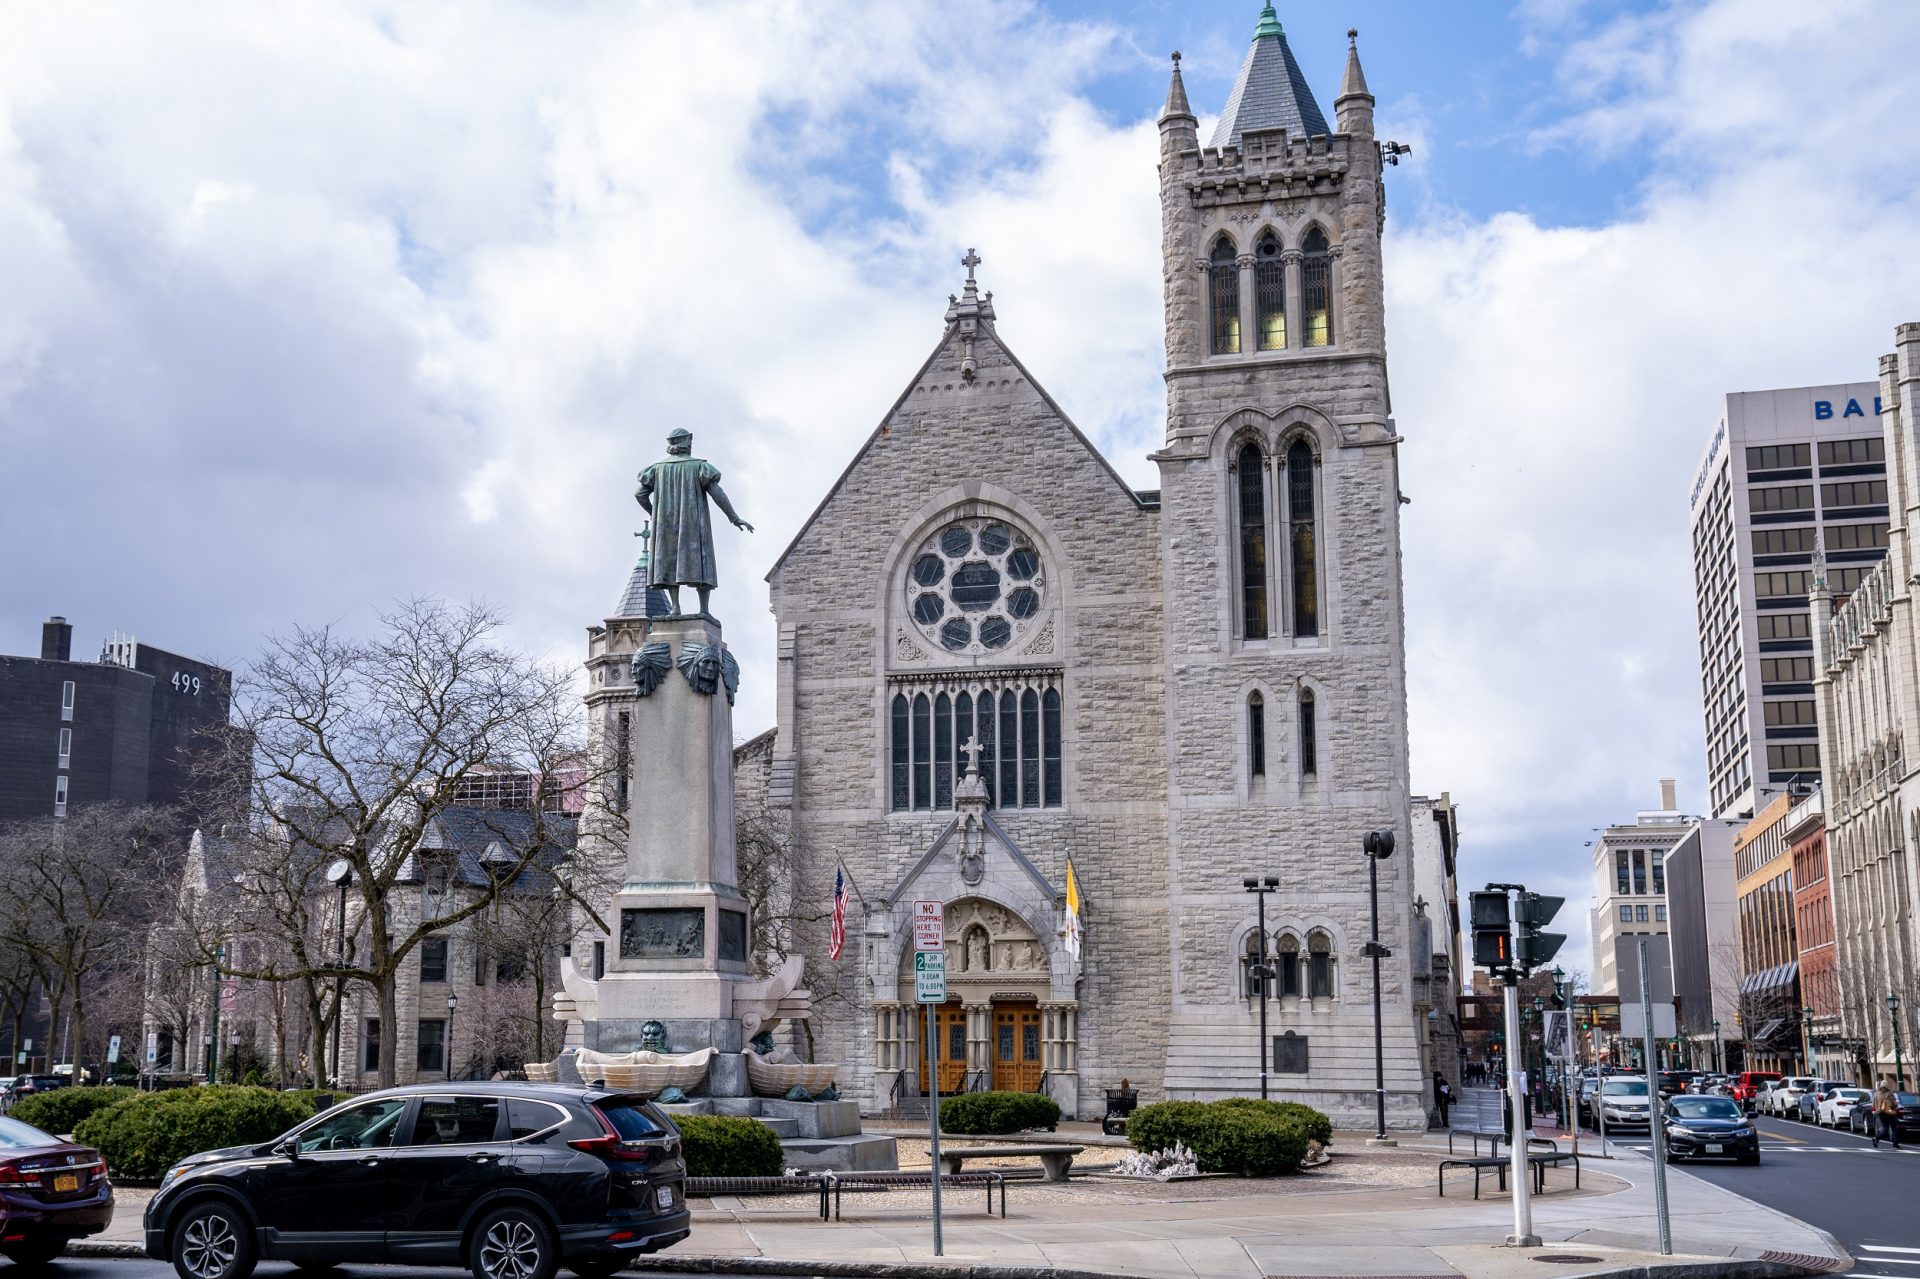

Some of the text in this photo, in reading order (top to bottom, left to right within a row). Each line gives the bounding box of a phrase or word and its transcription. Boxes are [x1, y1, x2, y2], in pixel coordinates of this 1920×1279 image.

[171, 671, 200, 696] 499
[922, 904, 934, 914] NO
[918, 932, 940, 940] CORNER
[918, 957, 924, 969] 2
[925, 962, 944, 970] PARKING
[919, 982, 944, 990] TO 6:00PM
